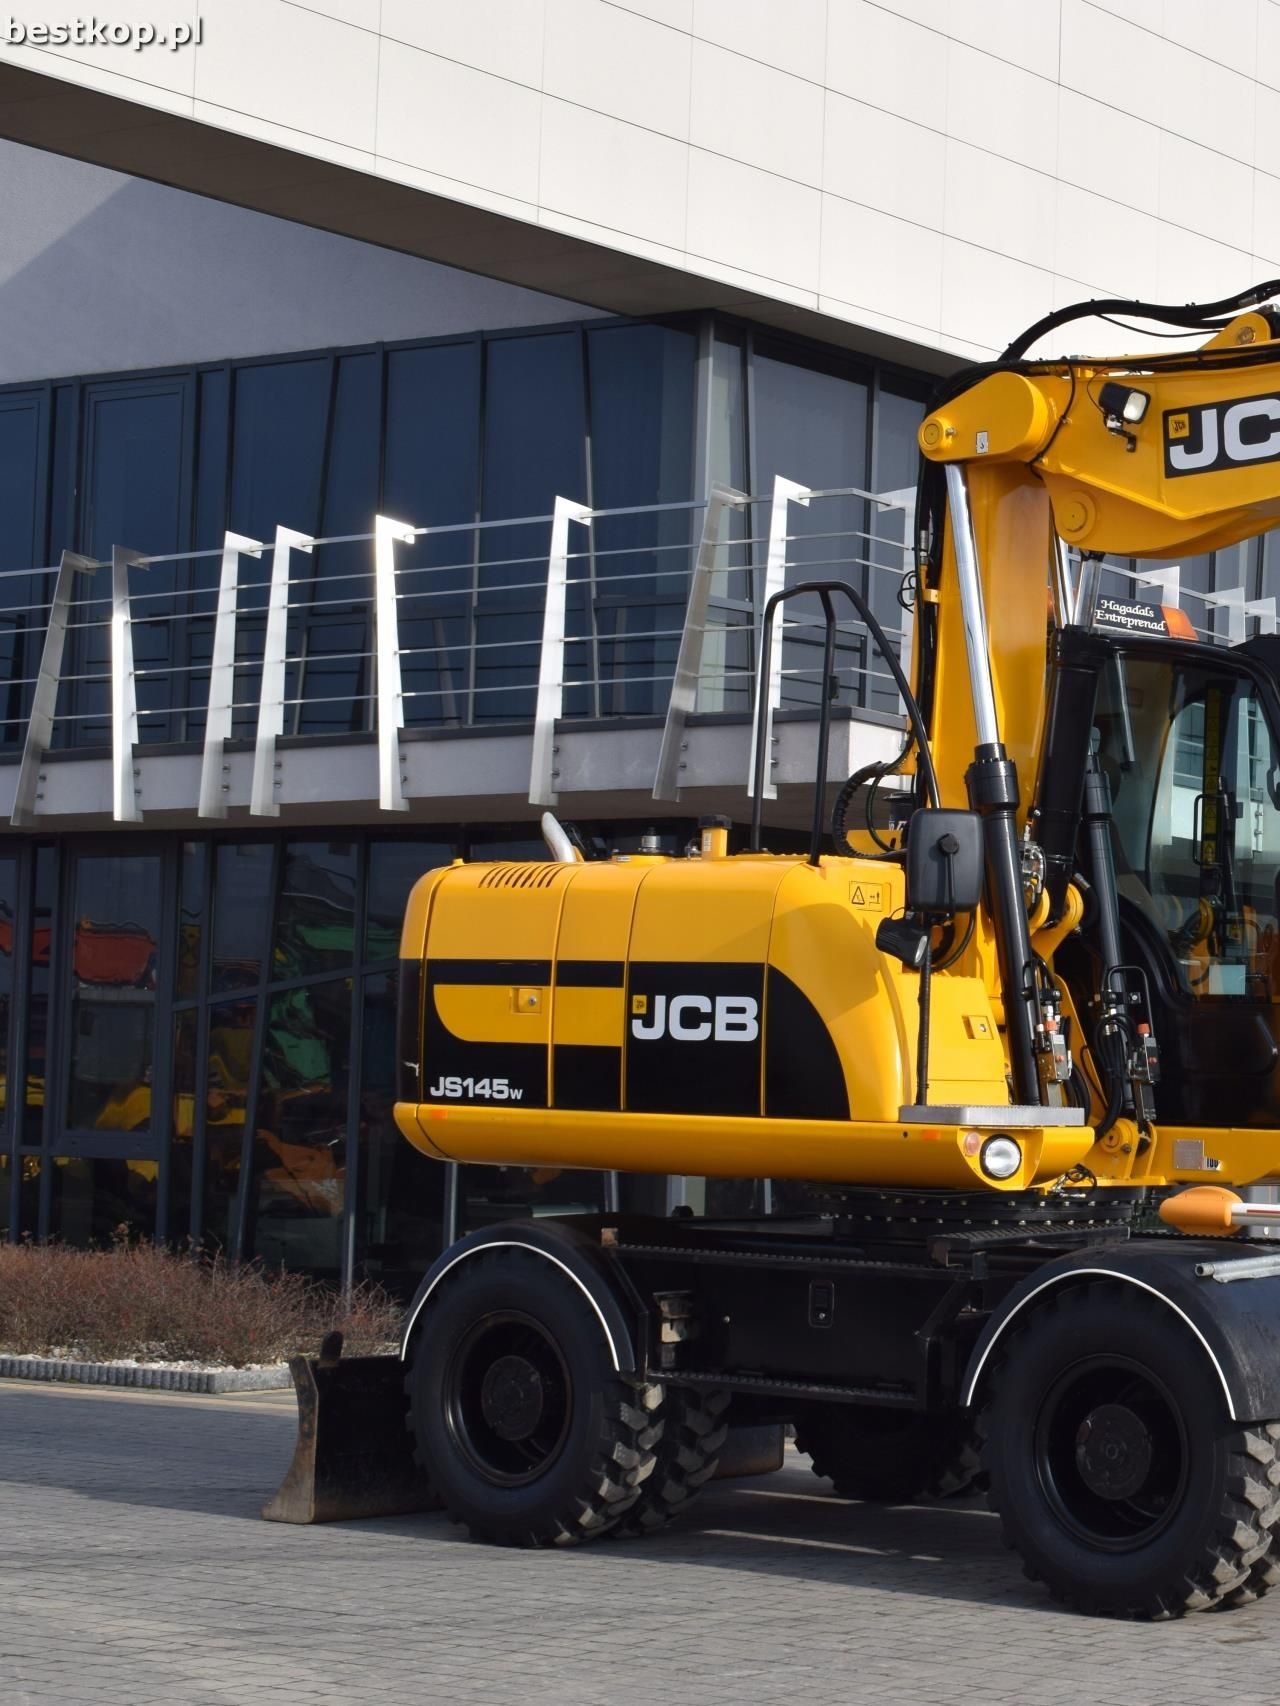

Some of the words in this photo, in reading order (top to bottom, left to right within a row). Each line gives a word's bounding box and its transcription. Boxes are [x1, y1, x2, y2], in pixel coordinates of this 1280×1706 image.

[1095, 609, 1166, 631] Entreprenad
[1101, 600, 1155, 618] Hagadals
[632, 994, 759, 1042] JCB
